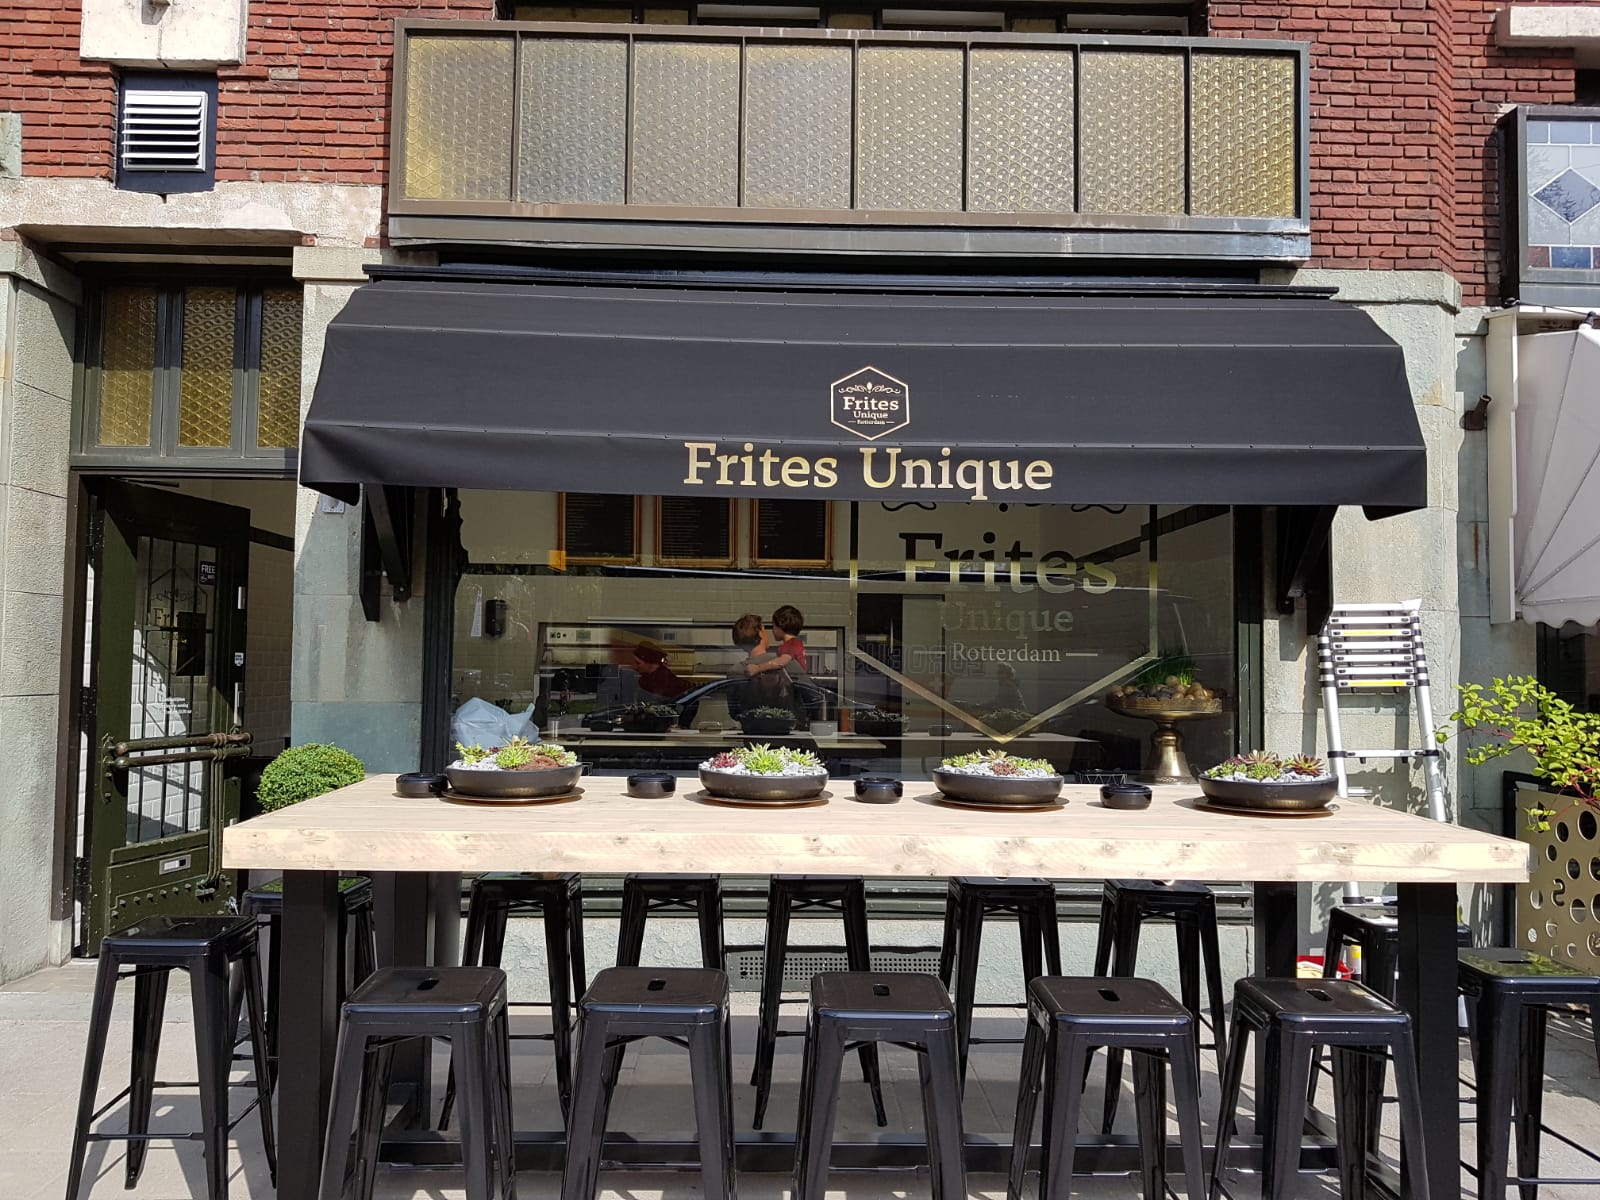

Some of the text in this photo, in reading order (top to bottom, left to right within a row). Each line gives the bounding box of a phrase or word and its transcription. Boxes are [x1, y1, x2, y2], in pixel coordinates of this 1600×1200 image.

[842, 396, 899, 411] Frites
[853, 411, 889, 420] Unique
[683, 441, 1054, 501] Frites Unique
[201, 564, 217, 574] FREE
[899, 531, 1118, 595] Frites
[936, 600, 1074, 640] Unique
[952, 642, 1062, 663] Rotterdam
